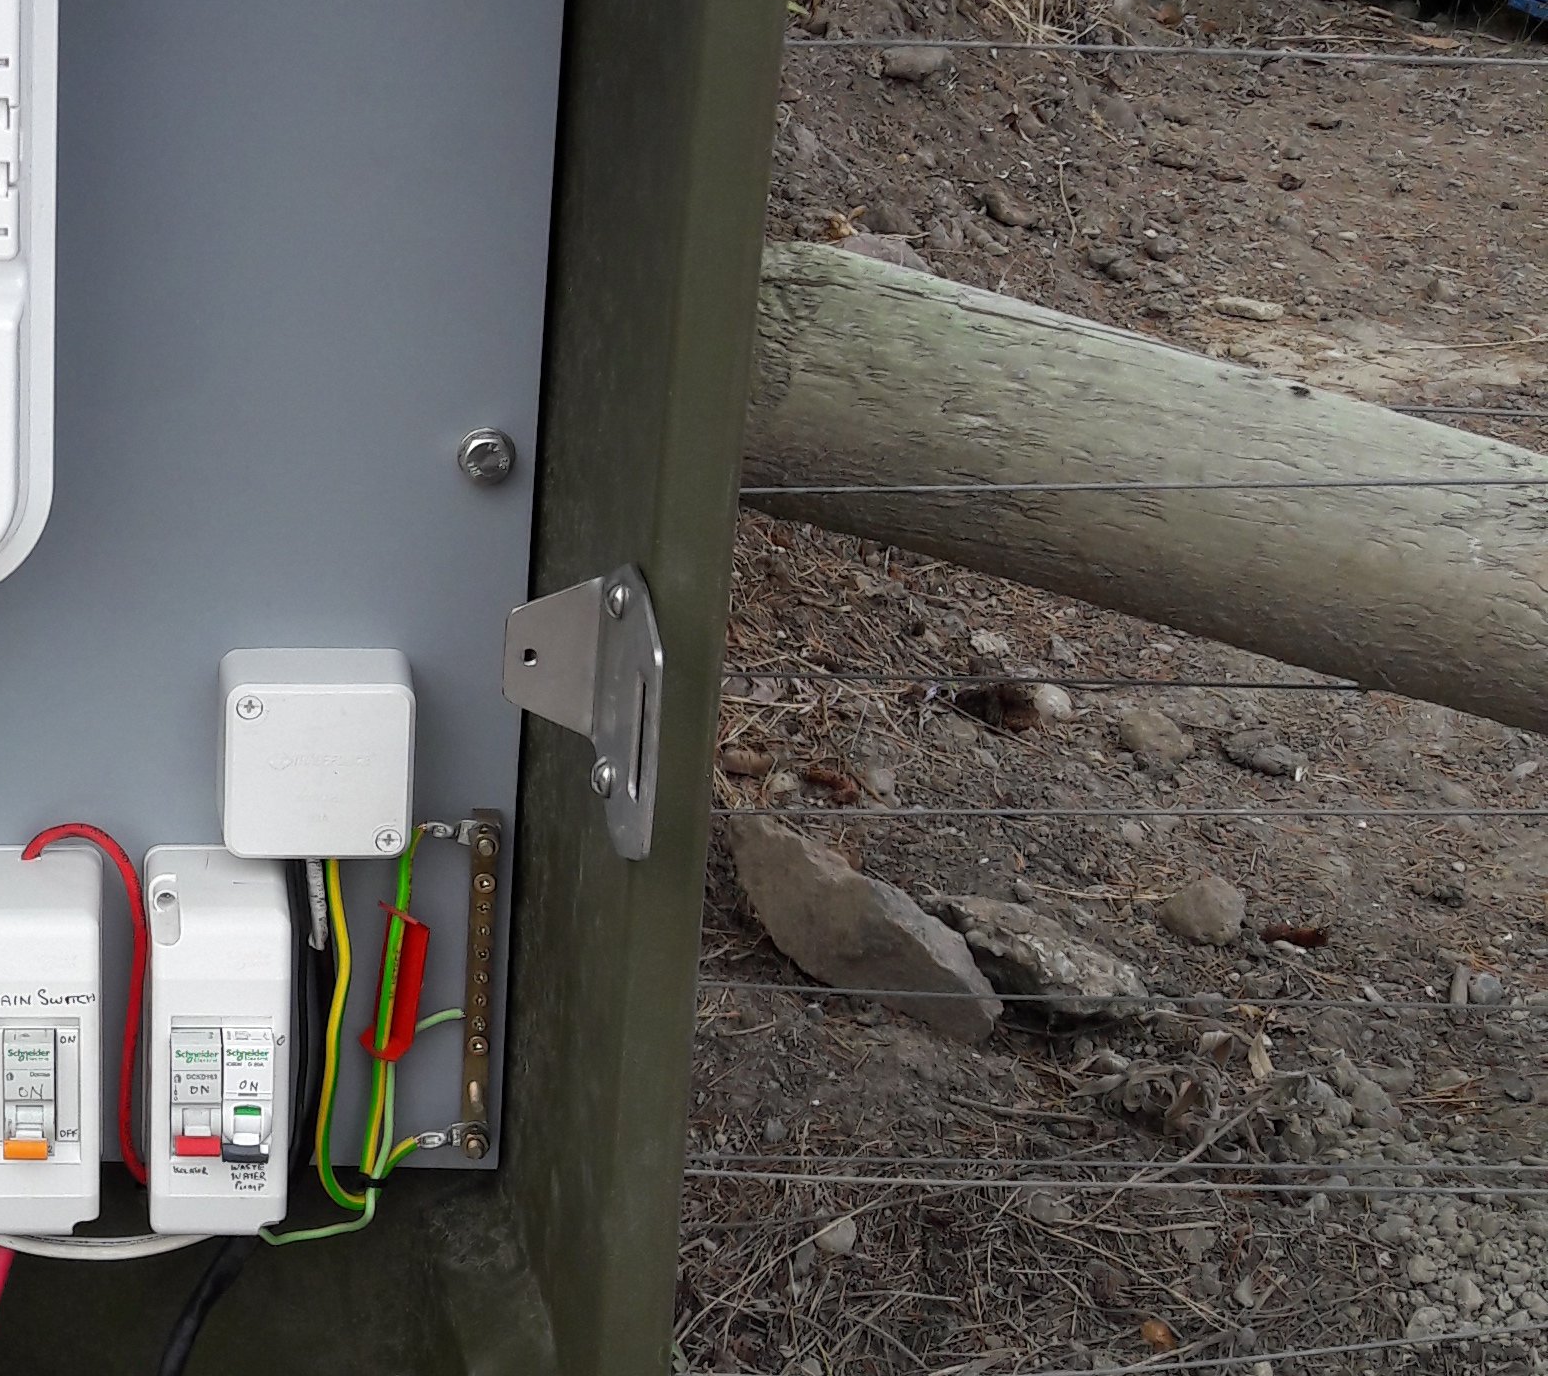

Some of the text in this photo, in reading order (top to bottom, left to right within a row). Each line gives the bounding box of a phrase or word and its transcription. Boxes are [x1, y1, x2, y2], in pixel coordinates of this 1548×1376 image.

[59, 1035, 77, 1045] ON
[7, 1048, 51, 1062] Schneider
[175, 1049, 219, 1063] Schneider
[226, 1048, 270, 1062] Schneider
[18, 1084, 44, 1100] ON
[190, 1085, 210, 1095] ON
[238, 1080, 259, 1092] ON
[59, 1129, 79, 1138] OFF
[231, 1171, 267, 1181] WATER
